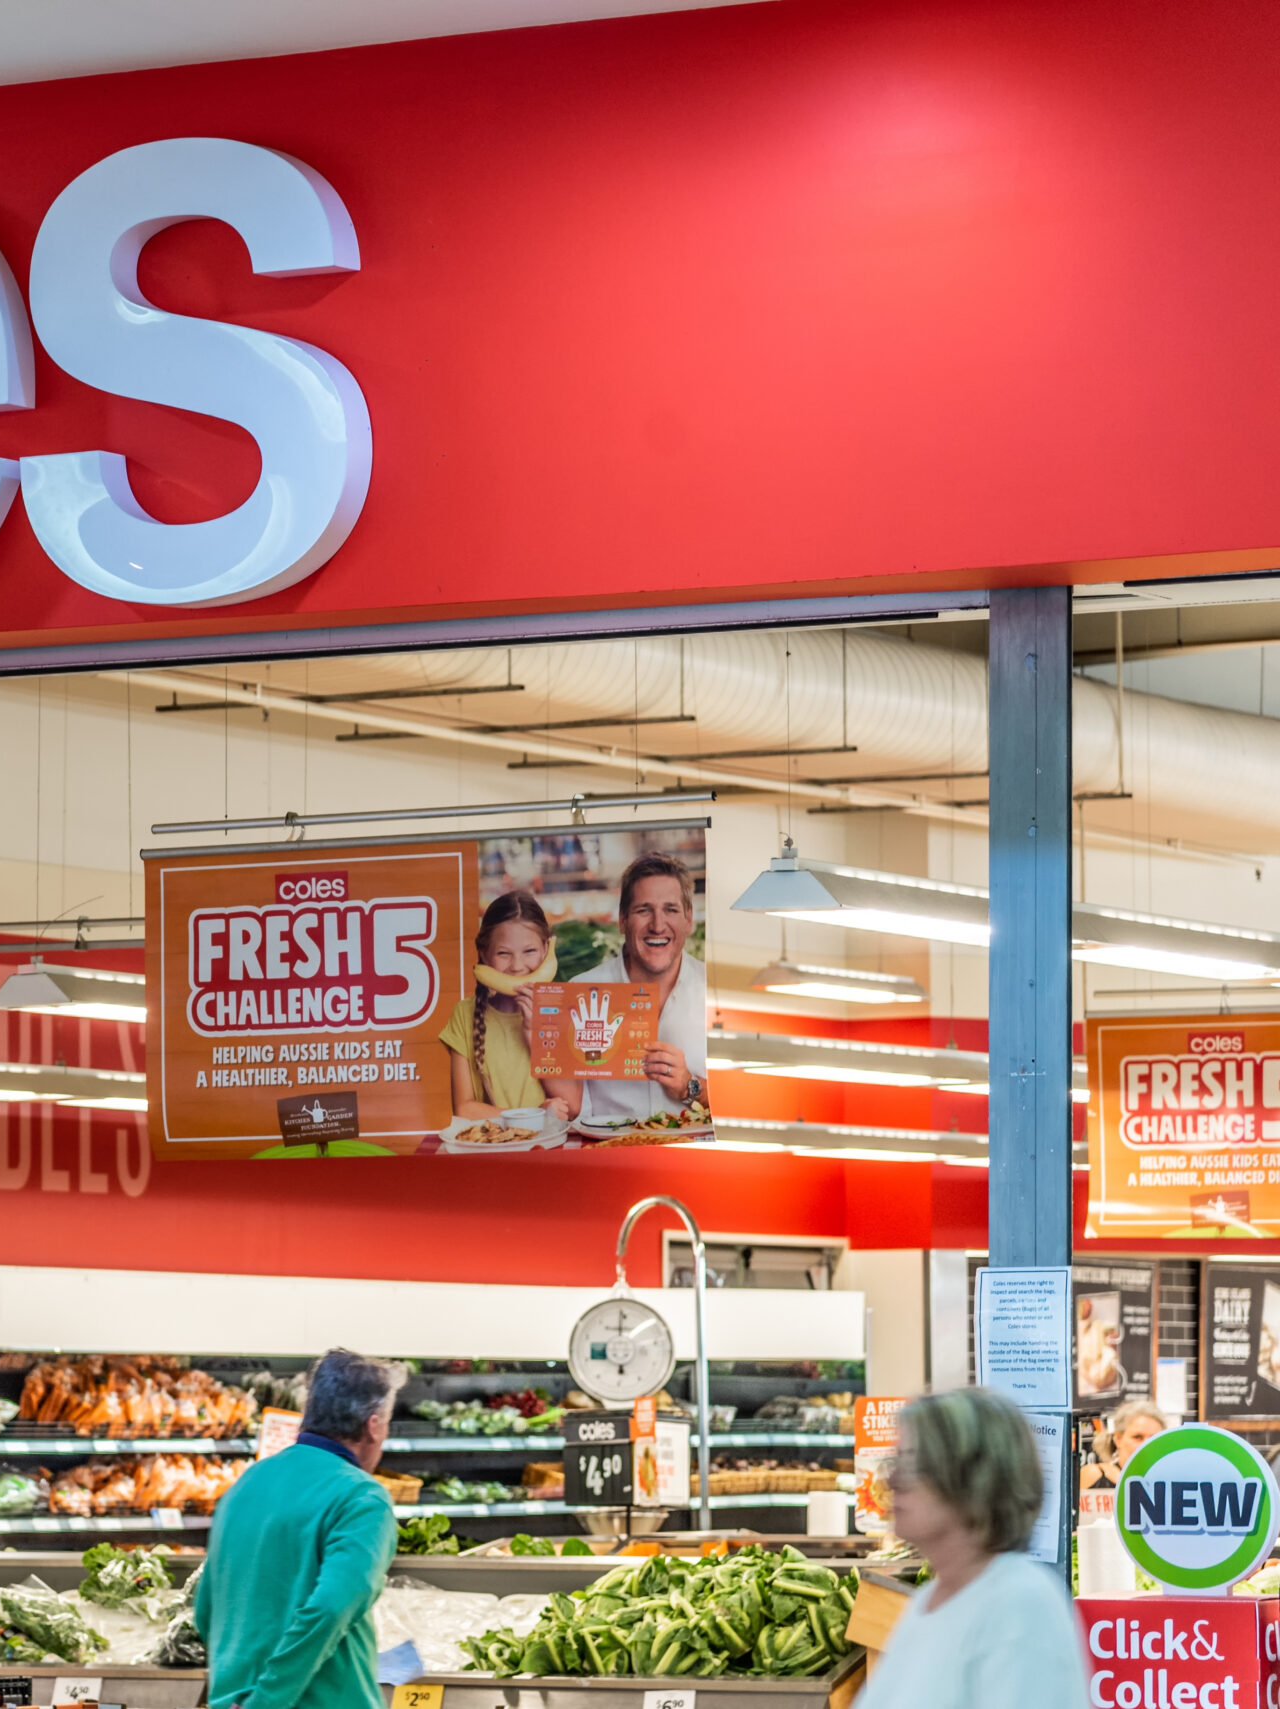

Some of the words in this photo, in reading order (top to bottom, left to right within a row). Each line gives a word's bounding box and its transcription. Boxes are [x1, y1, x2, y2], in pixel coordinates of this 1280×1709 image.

[278, 877, 345, 900] coles
[198, 912, 362, 983] FRESH
[373, 907, 430, 1020] 5
[196, 986, 364, 1026] CHALLENGE
[576, 1030, 602, 1041] FRESH
[1191, 1035, 1243, 1053] coles
[212, 1045, 274, 1065] HELPING
[278, 1043, 330, 1062] AUSSIE
[334, 1042, 370, 1060] KIDS
[375, 1040, 402, 1058] EAT
[196, 1071, 208, 1088] A
[212, 1067, 293, 1089] HEALTHIER,
[297, 1065, 379, 1085] BALANCED
[384, 1063, 420, 1081] DIET.
[1127, 1060, 1254, 1110] FRESH
[1126, 1114, 1255, 1143] CHALLENGE
[1140, 1155, 1187, 1170] HELPING
[1190, 1155, 1229, 1169] AUSSIE
[1232, 1154, 1259, 1168] KIDS
[1127, 1173, 1137, 1187] A
[1140, 1171, 1201, 1187] HEALTHIER,
[1204, 1170, 1266, 1185] BALANCED
[866, 1402, 876, 1415] A
[578, 1420, 616, 1441] coles
[1129, 1481, 1258, 1527] NEW
[1090, 1668, 1239, 1709] Collect
